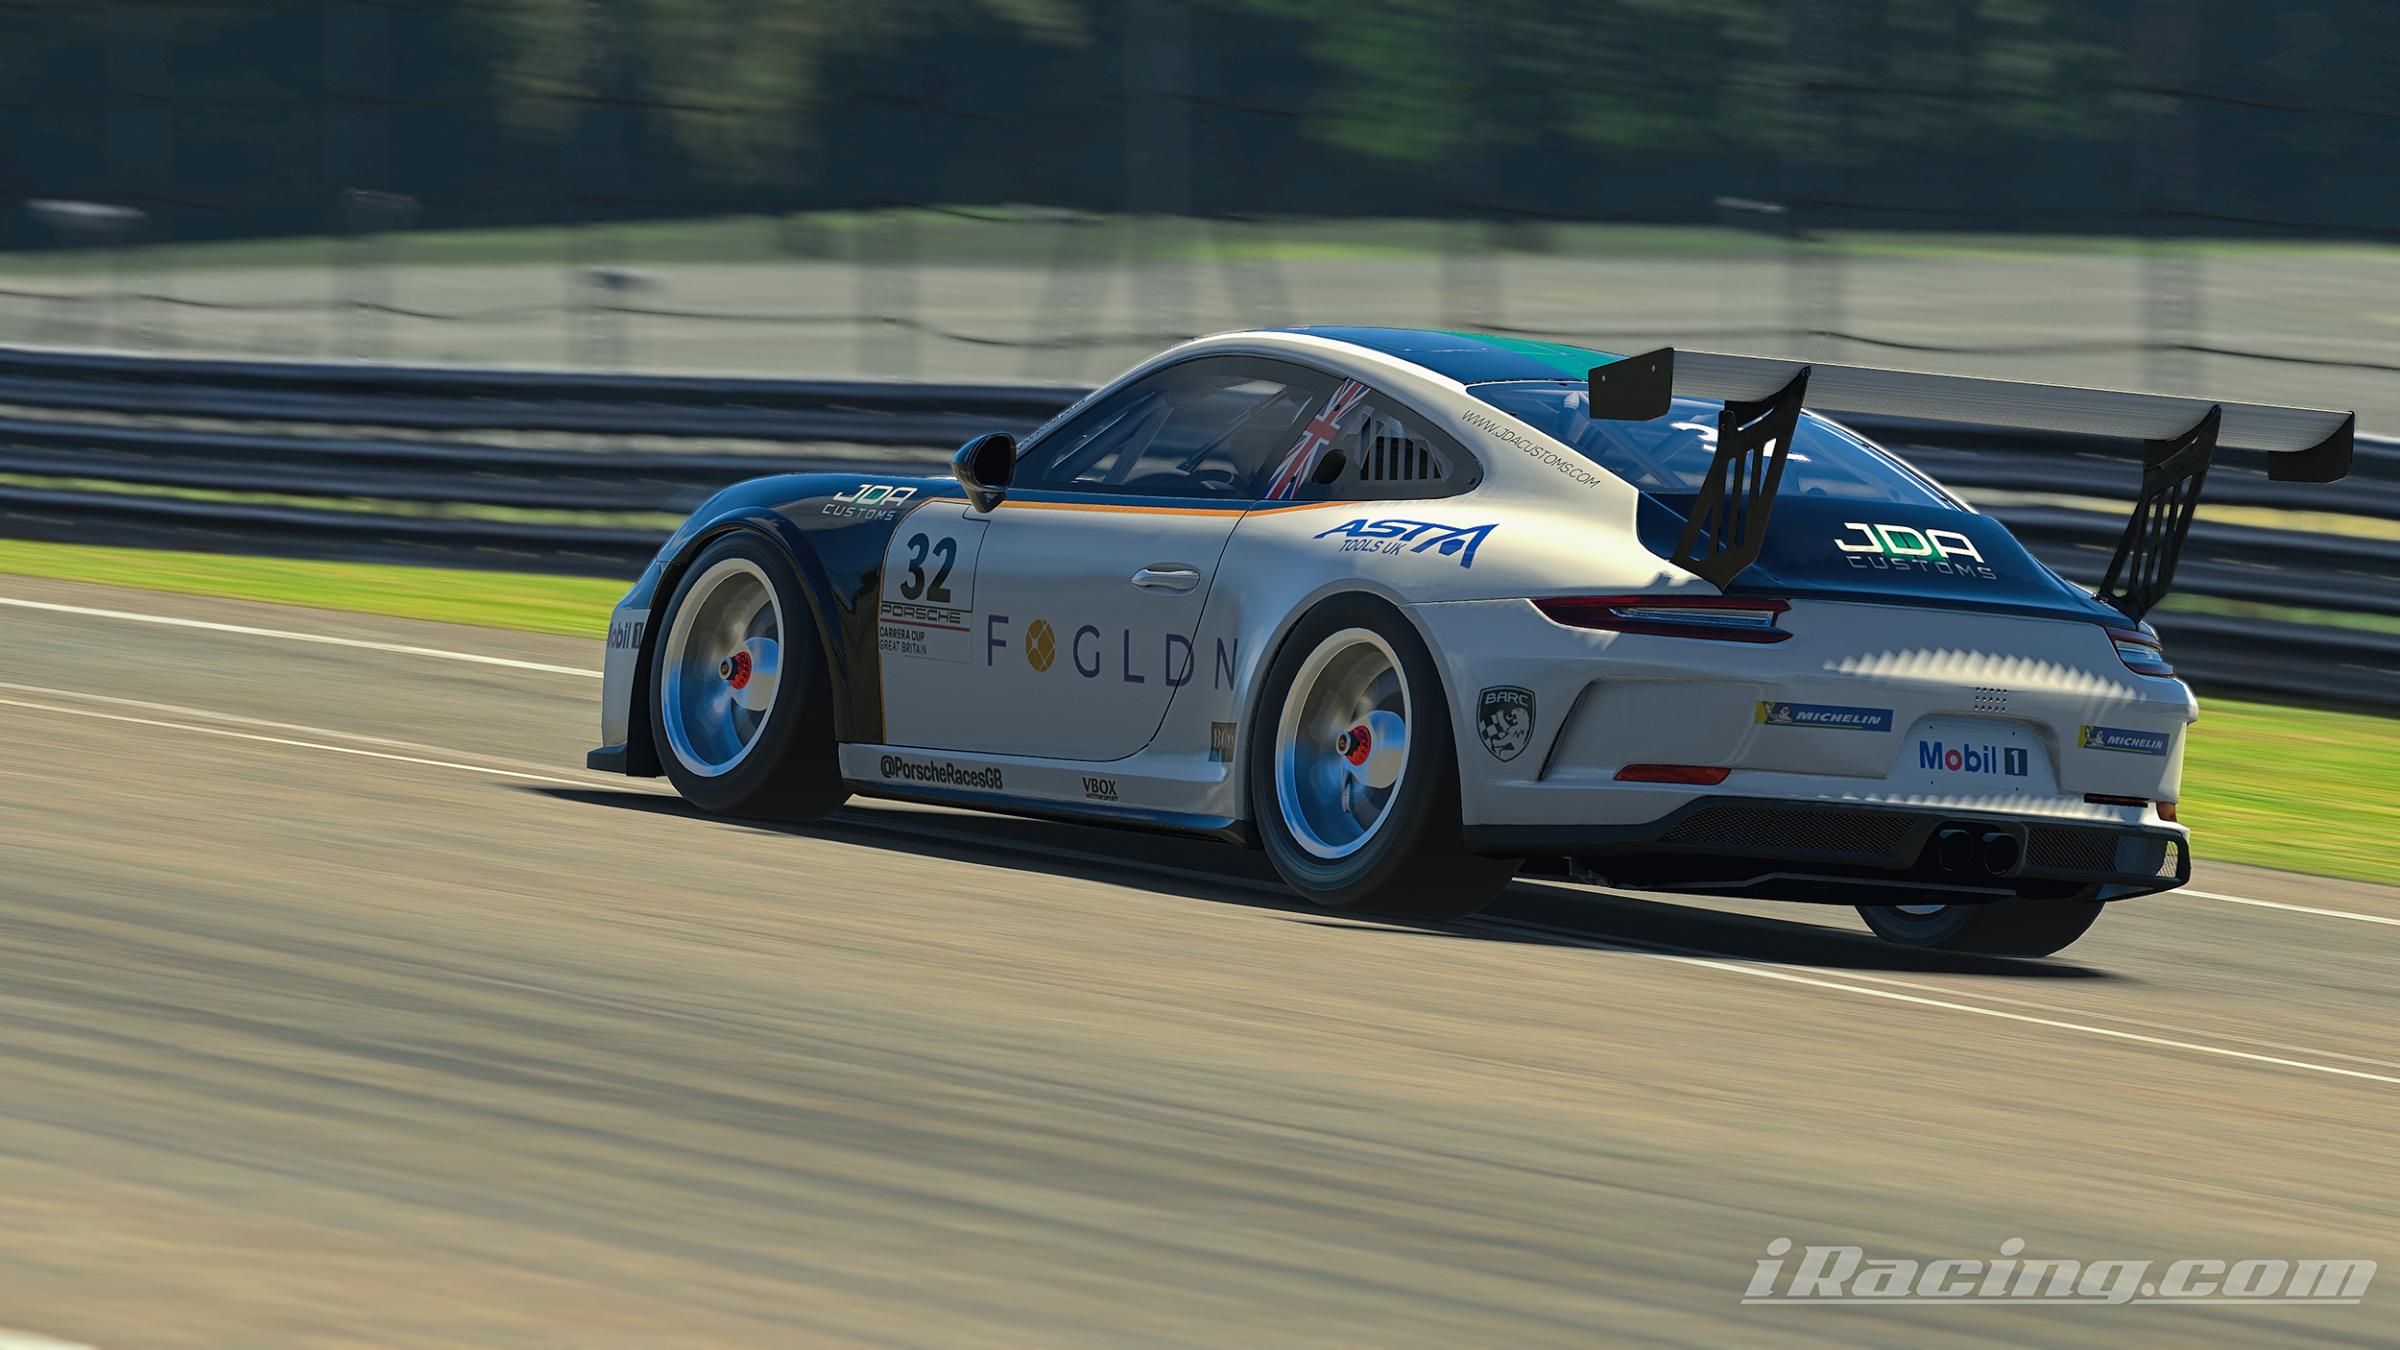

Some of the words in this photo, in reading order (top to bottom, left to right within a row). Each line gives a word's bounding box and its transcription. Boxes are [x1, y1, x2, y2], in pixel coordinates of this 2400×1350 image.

[832, 484, 918, 506] JDA
[822, 503, 897, 521] CUSTOMS
[1313, 518, 1500, 569] ASTA
[1339, 539, 1382, 552] TOOLS
[1382, 541, 1405, 556] UK
[1834, 522, 1985, 563] JDA
[900, 533, 957, 603] 32
[1846, 556, 1998, 580] CUSTOMS
[880, 604, 961, 624] PORSCHE
[879, 627, 910, 641] CARRERA
[912, 630, 926, 642] CUP
[879, 639, 900, 652] GREAT
[902, 641, 927, 655] BRITAIN
[1485, 692, 1528, 707] BARC
[1796, 711, 1881, 725] MICHELIN
[2107, 735, 2163, 750] MICHELIN
[1919, 740, 1997, 774] Mobil
[880, 755, 1003, 790] @PorscheRacesGB
[1082, 776, 1117, 796] VBOX
